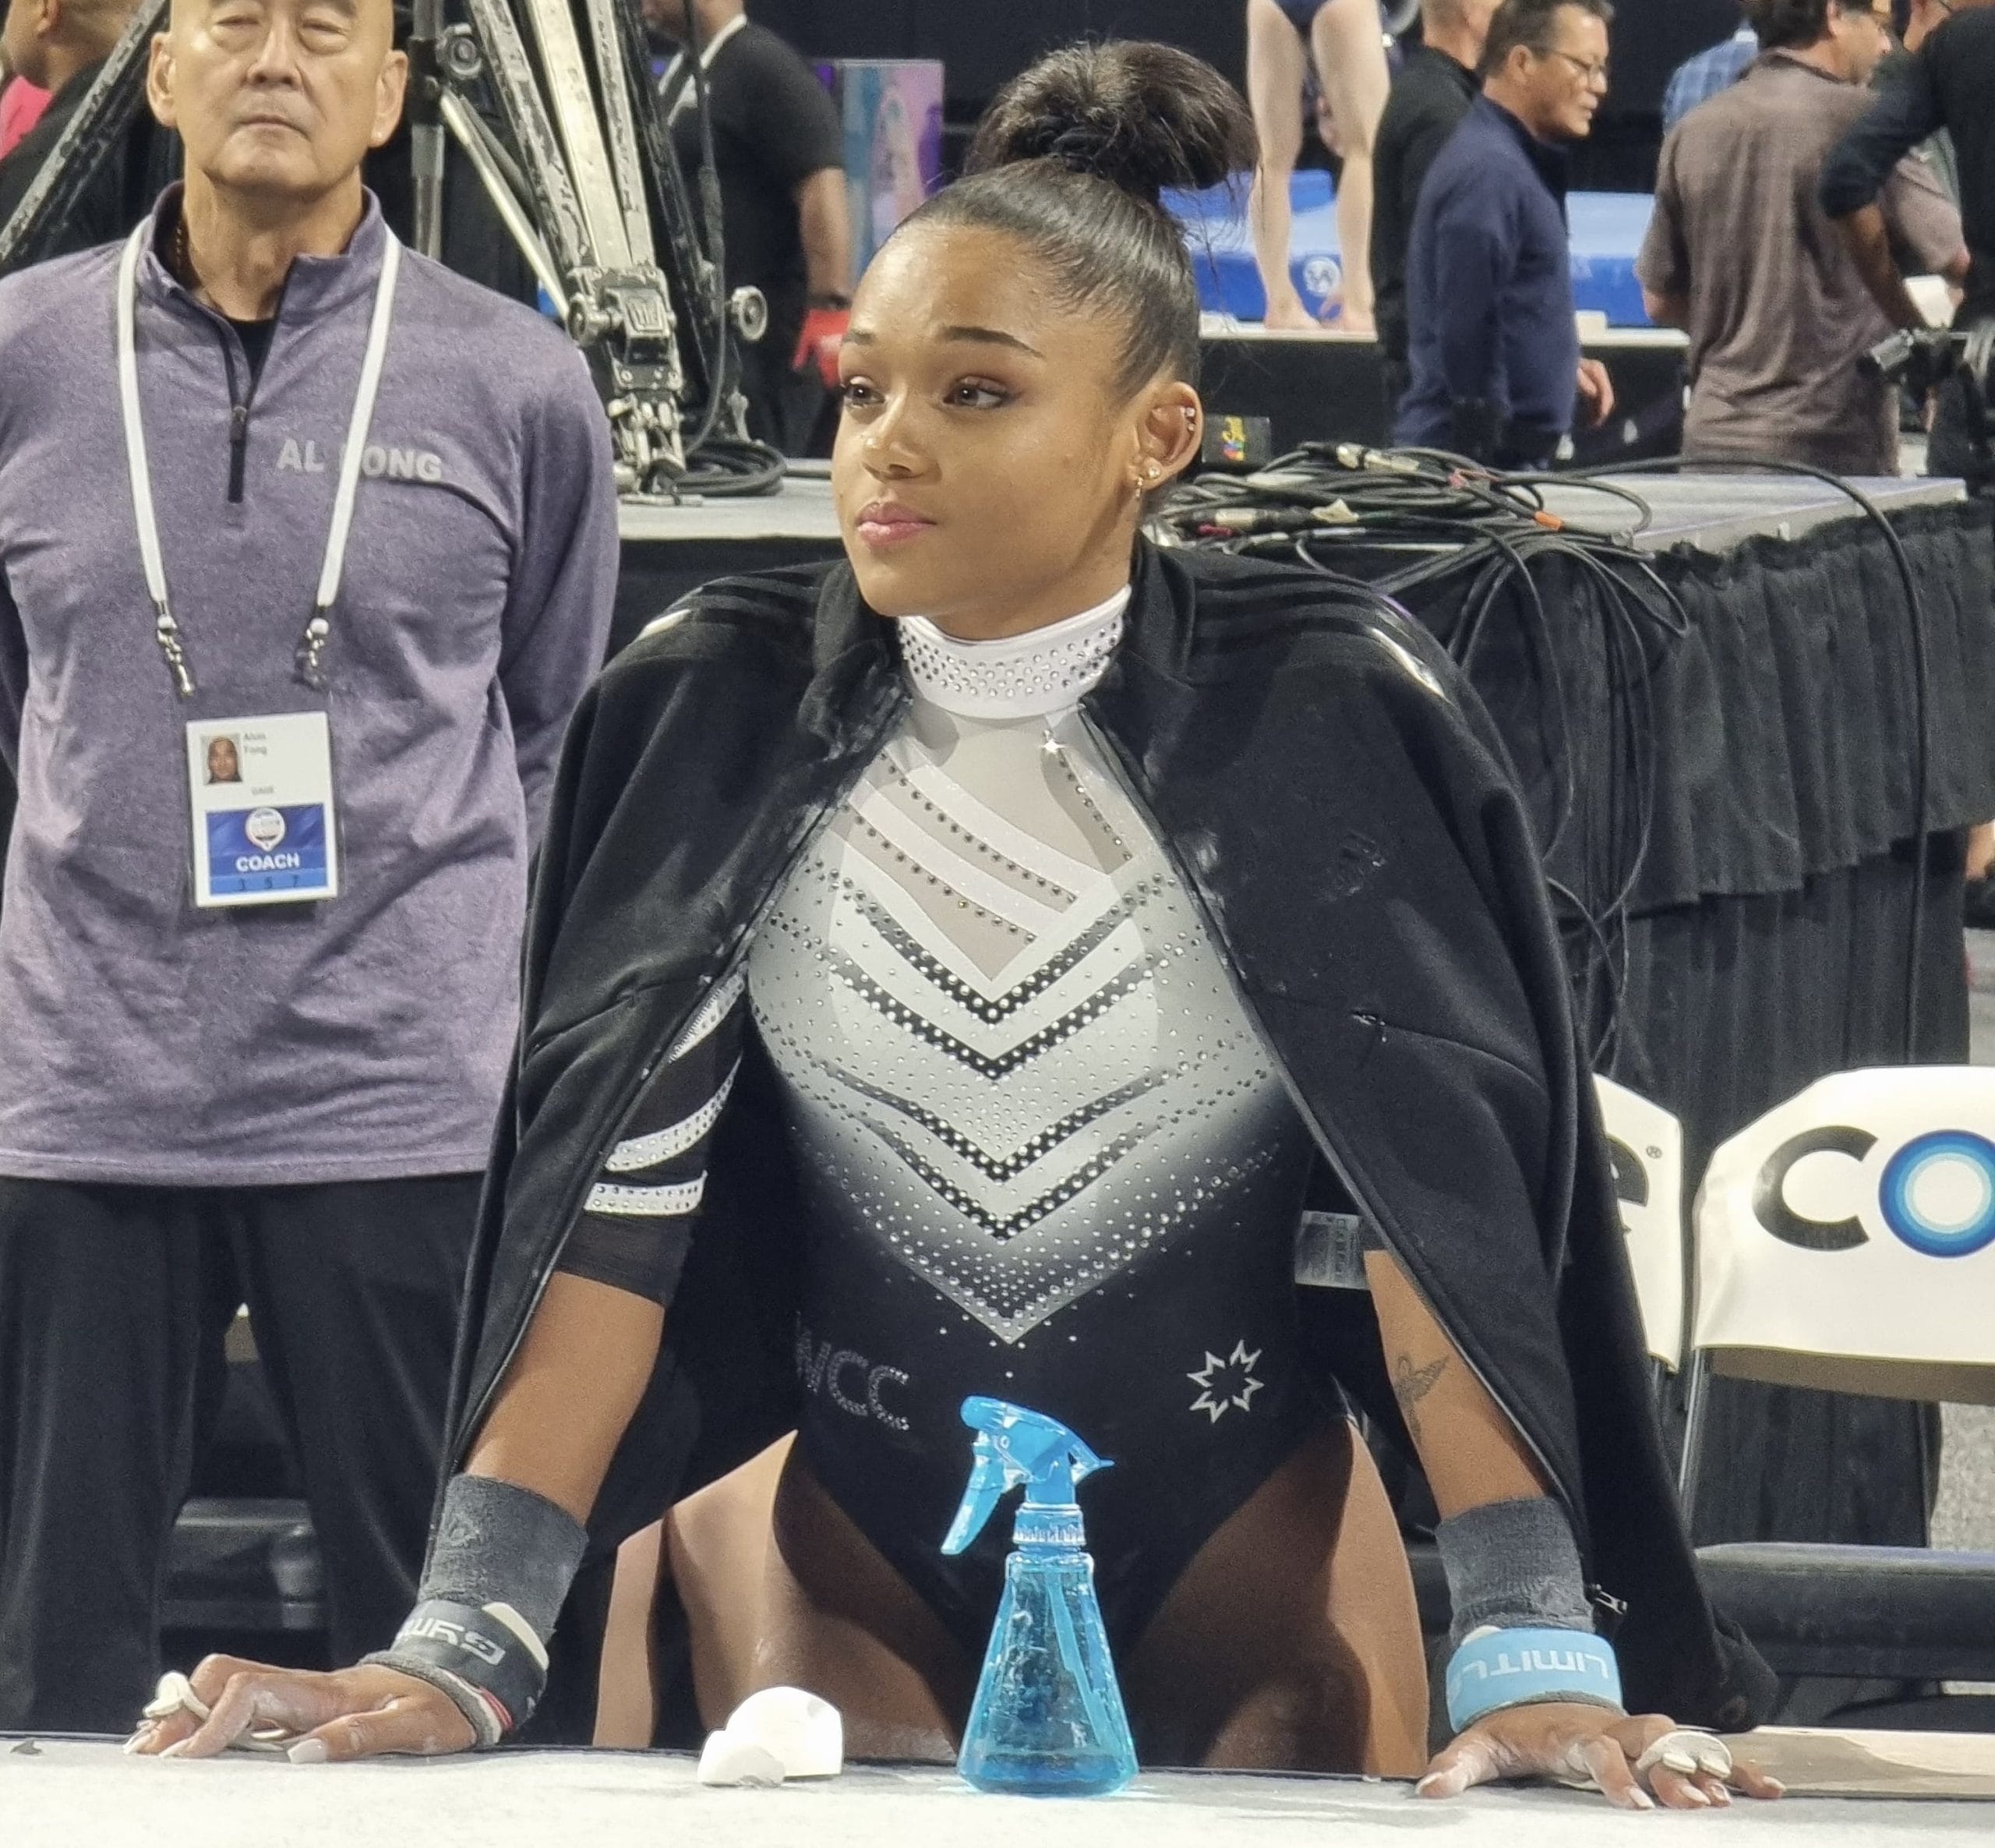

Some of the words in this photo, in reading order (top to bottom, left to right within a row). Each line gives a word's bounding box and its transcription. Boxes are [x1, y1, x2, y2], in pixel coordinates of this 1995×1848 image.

[275, 439, 324, 472] AL
[338, 443, 443, 482] ONG
[236, 852, 300, 872] COACH
